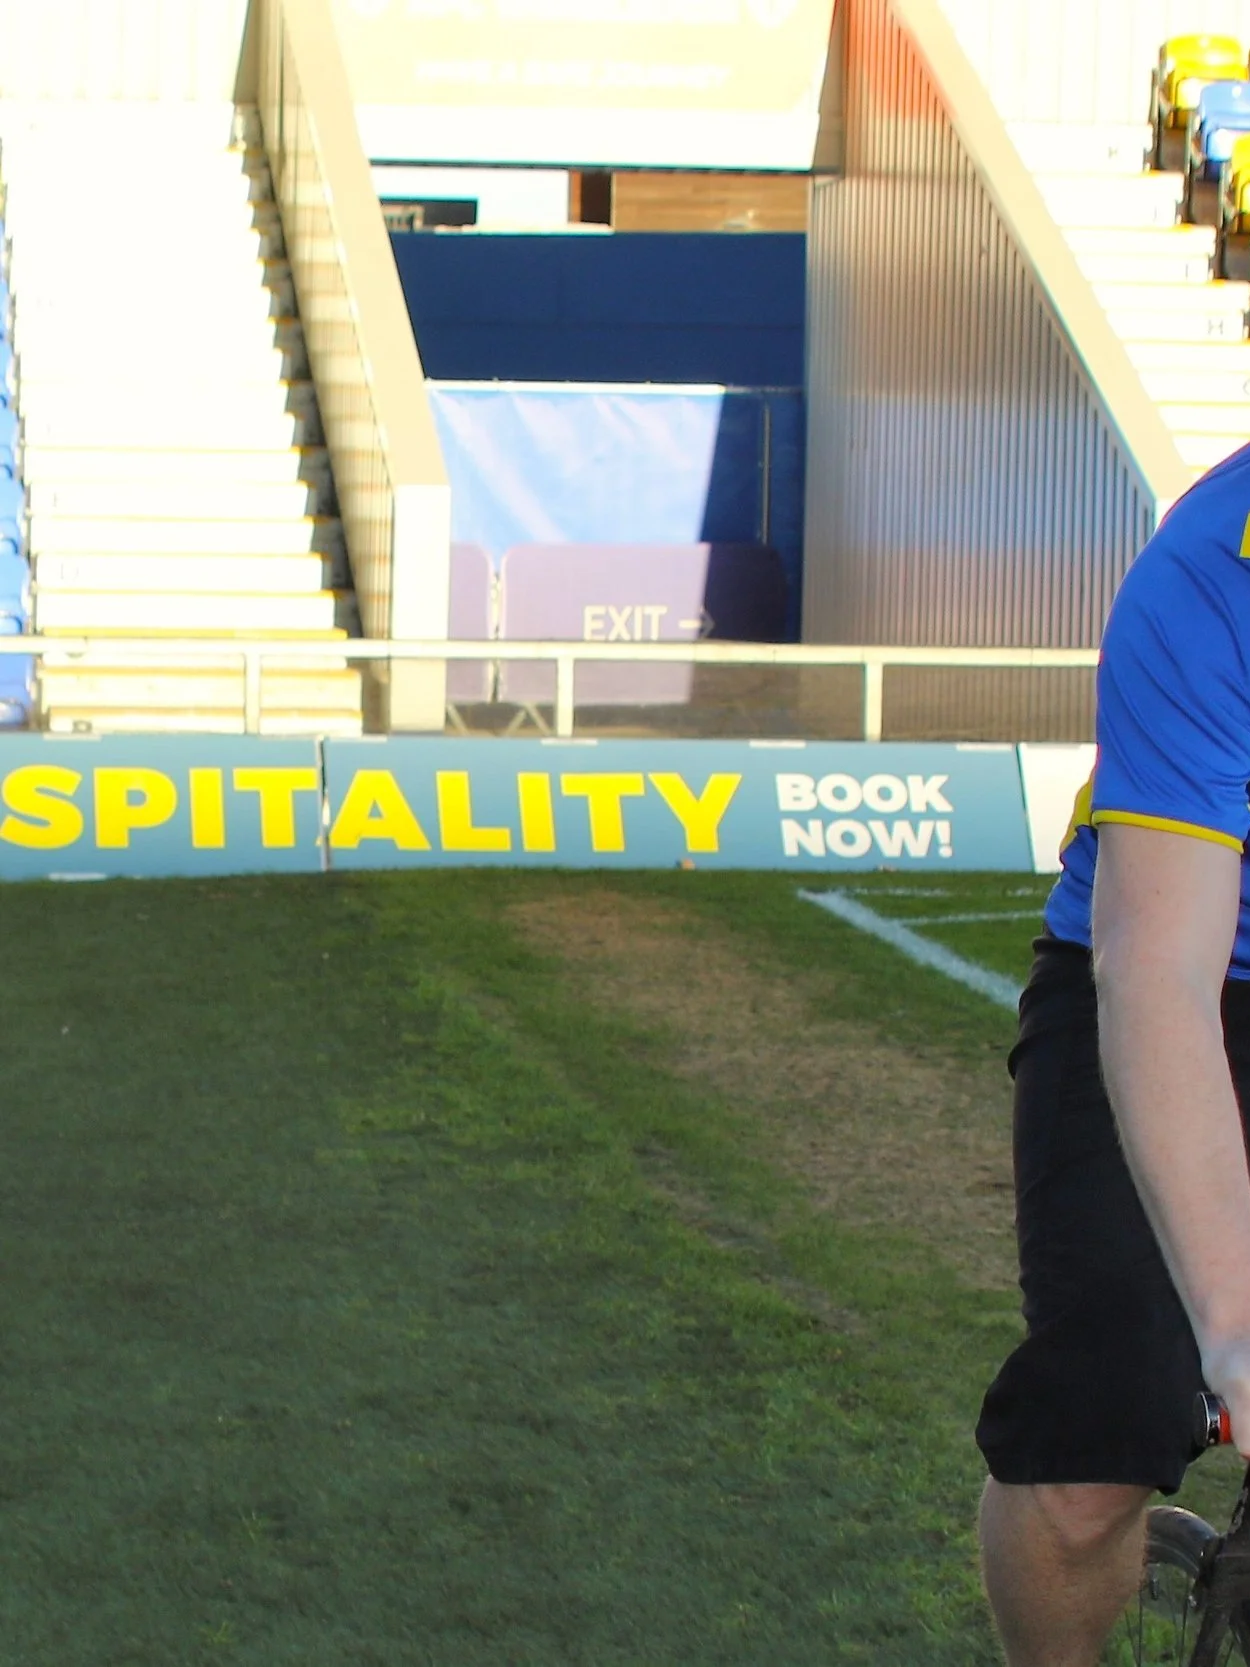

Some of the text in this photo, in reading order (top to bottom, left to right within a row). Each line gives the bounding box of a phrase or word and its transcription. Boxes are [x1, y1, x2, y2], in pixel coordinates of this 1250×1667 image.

[583, 604, 669, 641] EXIT
[0, 764, 743, 853] SPITALITY
[775, 772, 954, 813] BOOK
[780, 818, 953, 858] NOW!
